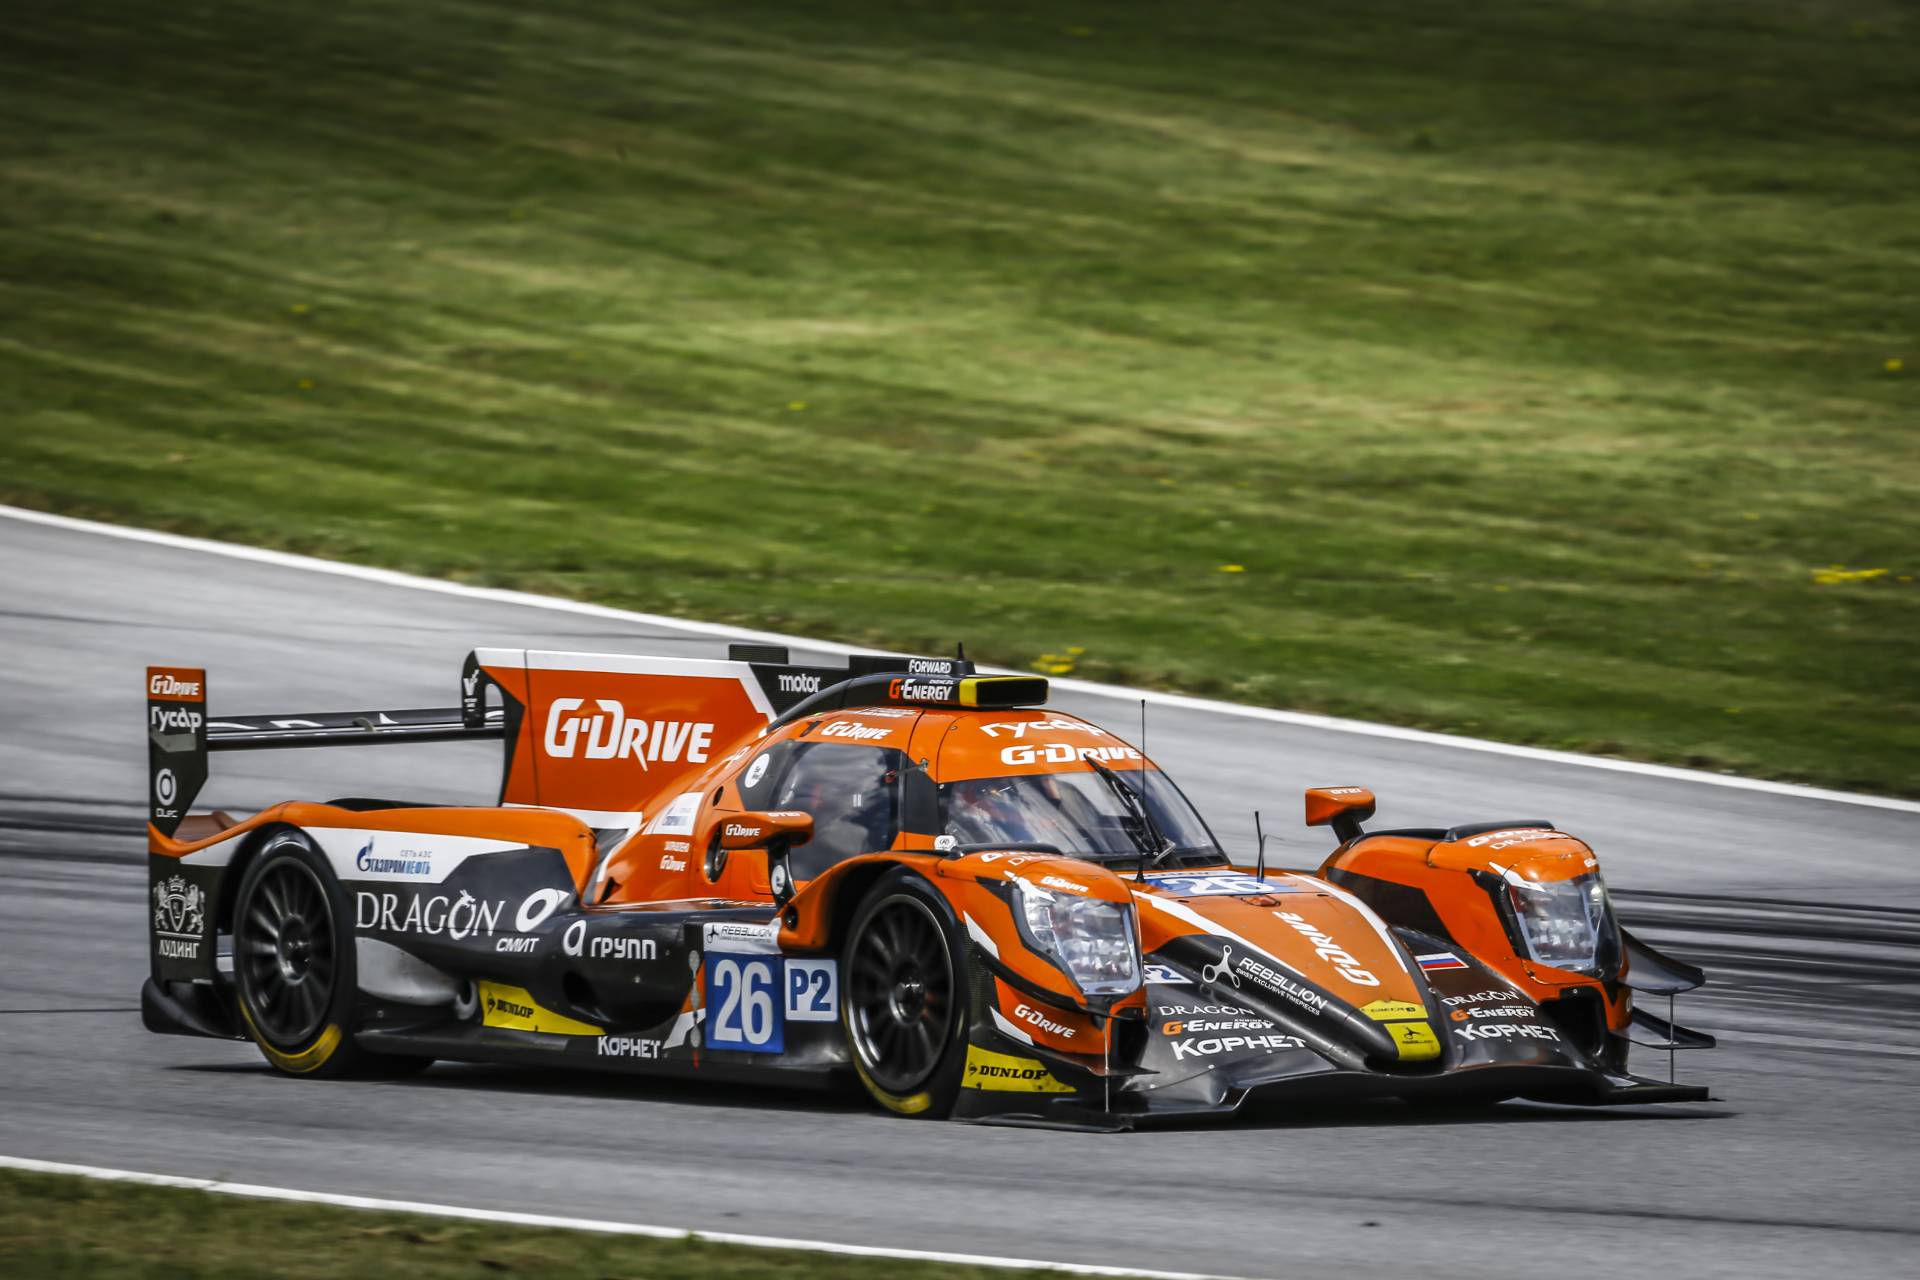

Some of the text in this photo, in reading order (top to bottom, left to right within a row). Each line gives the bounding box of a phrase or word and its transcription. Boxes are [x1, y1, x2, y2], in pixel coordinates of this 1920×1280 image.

[908, 659, 952, 674] FORWARD
[778, 673, 821, 693] motor
[356, 890, 506, 941] DRAGON
[789, 968, 832, 1012] P2
[496, 998, 534, 1019] DUNLOP
[714, 959, 774, 1045] 26
[1158, 1005, 1256, 1016] DRAGON
[978, 1064, 1050, 1080] DUNLOP
